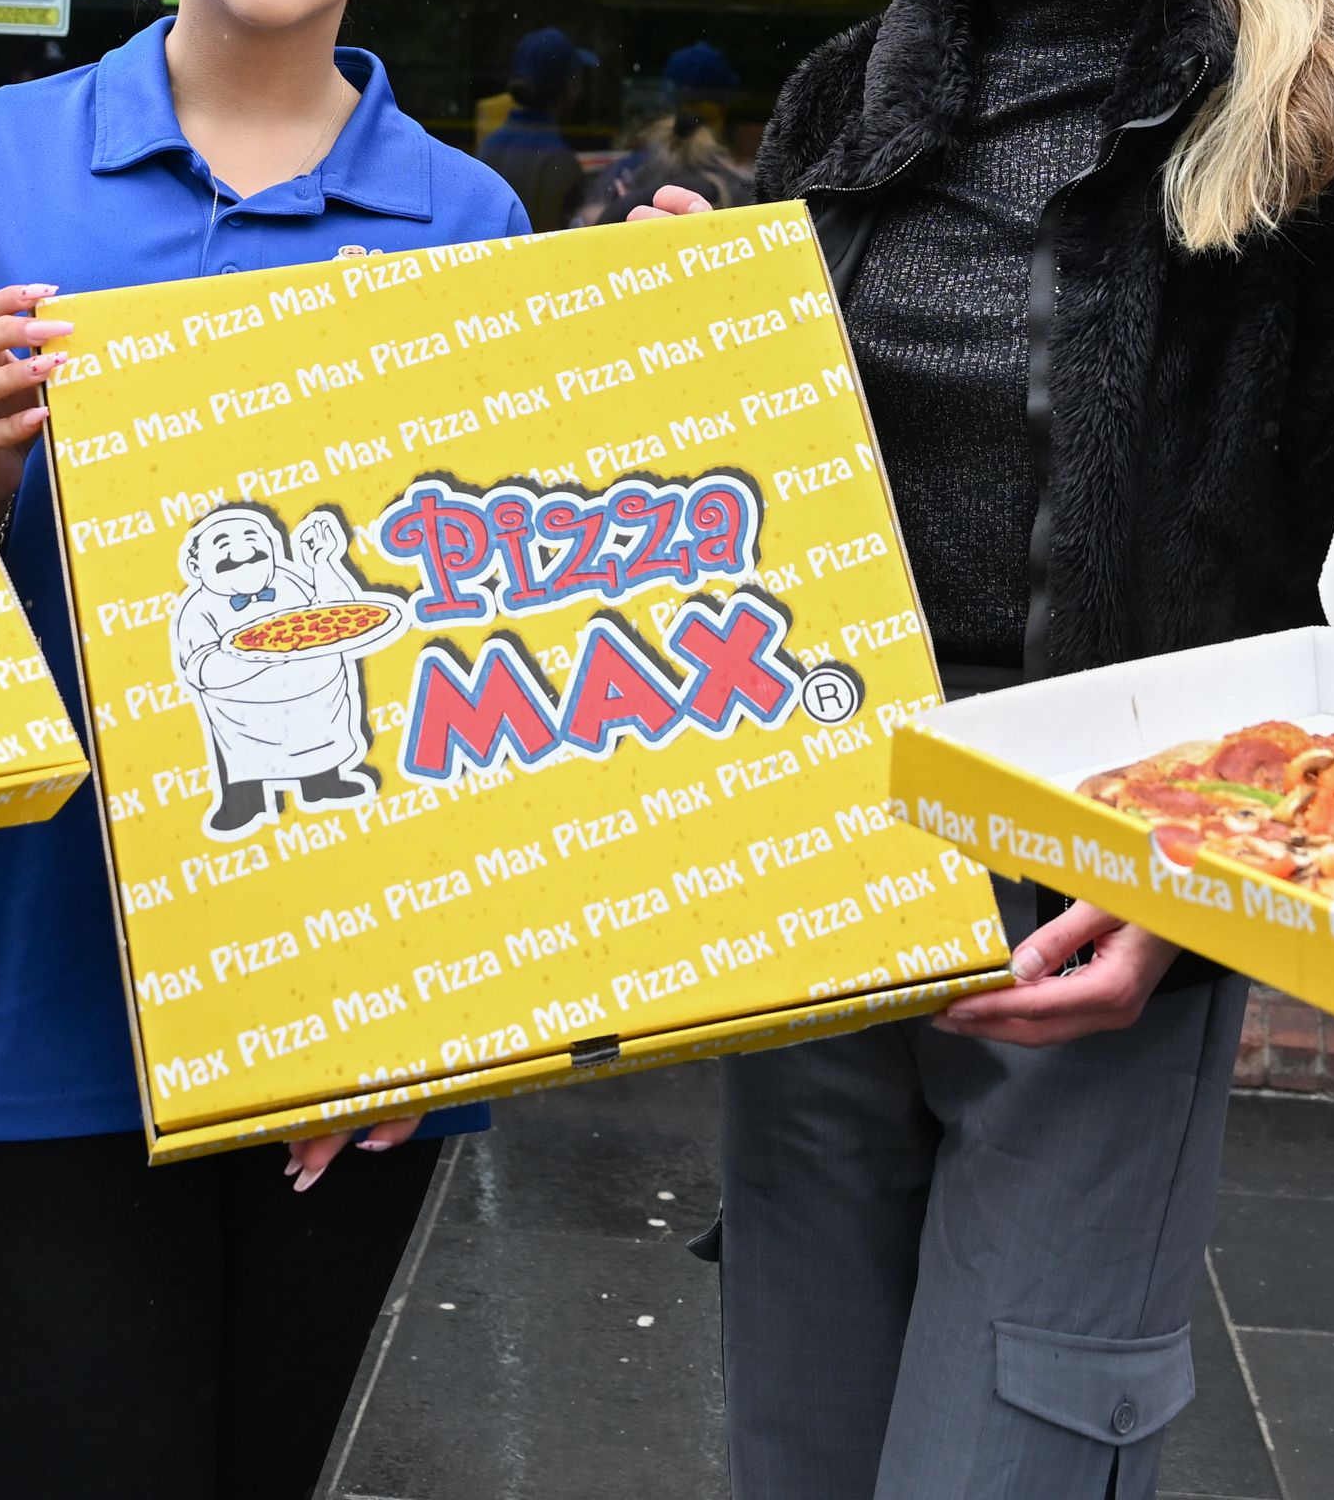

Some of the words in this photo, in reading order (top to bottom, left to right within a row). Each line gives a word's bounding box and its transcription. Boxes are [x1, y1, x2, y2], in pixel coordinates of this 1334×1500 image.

[49, 351, 103, 386] zza
[107, 330, 176, 370] Max
[182, 304, 265, 347] Pizza
[269, 282, 336, 321] Max
[342, 256, 423, 299] Pizza
[133, 408, 203, 448] Max
[209, 382, 292, 425] Pizza
[296, 359, 364, 398] Max
[369, 332, 451, 376] Pizza
[454, 310, 521, 349] Max
[526, 284, 605, 325] Pizza
[608, 263, 673, 300] Max
[678, 236, 755, 277] Pizza
[71, 511, 156, 554] Pizza
[236, 460, 320, 502] Pizza
[324, 436, 393, 476] Max
[398, 409, 480, 452] Pizza
[483, 386, 551, 425] Max
[555, 359, 635, 401] Pizza
[638, 336, 704, 375] Max
[708, 309, 787, 351] Pizza
[789, 291, 836, 323] Ma
[586, 435, 667, 479] Pizza
[669, 411, 736, 450] Max
[740, 383, 820, 426] Pizza
[125, 680, 191, 720] Pizz
[773, 457, 854, 501] Pizza
[380, 481, 753, 624] Pizza
[26, 715, 79, 751] Piz
[108, 788, 145, 821] ax
[807, 532, 888, 578] Pizza
[181, 844, 269, 893] Pizza
[274, 816, 347, 861] Max
[355, 785, 439, 834] Pizza
[840, 609, 922, 657] Pizza
[404, 598, 796, 781] MAX
[130, 965, 203, 1005] Max
[210, 932, 299, 983] Pizza
[304, 903, 378, 948] Max
[384, 870, 472, 920] Pizza
[475, 842, 548, 887] Max
[552, 809, 639, 859] Pizza
[641, 782, 712, 826] Max
[716, 750, 801, 798] Pizza
[802, 720, 873, 767] Max
[154, 1049, 230, 1099] Max
[237, 1014, 328, 1067] Pizza
[332, 984, 407, 1032] Max
[413, 950, 502, 1002] Pizza
[505, 921, 579, 968] Max
[583, 888, 670, 938] Pizza
[672, 859, 744, 905] Max
[747, 827, 833, 876] Pizza
[834, 800, 895, 843] Ma
[897, 938, 968, 980] Max
[917, 796, 979, 846] Max
[987, 814, 1064, 869] Pizza
[1072, 835, 1139, 887] Max
[1149, 853, 1233, 912] Pizza
[1242, 878, 1316, 932] Max
[440, 1024, 530, 1070] Pizza
[532, 993, 607, 1041] Max
[611, 960, 699, 1011] Pizza
[701, 931, 774, 977] Max
[777, 898, 863, 947] Pizza
[864, 868, 936, 913] Max
